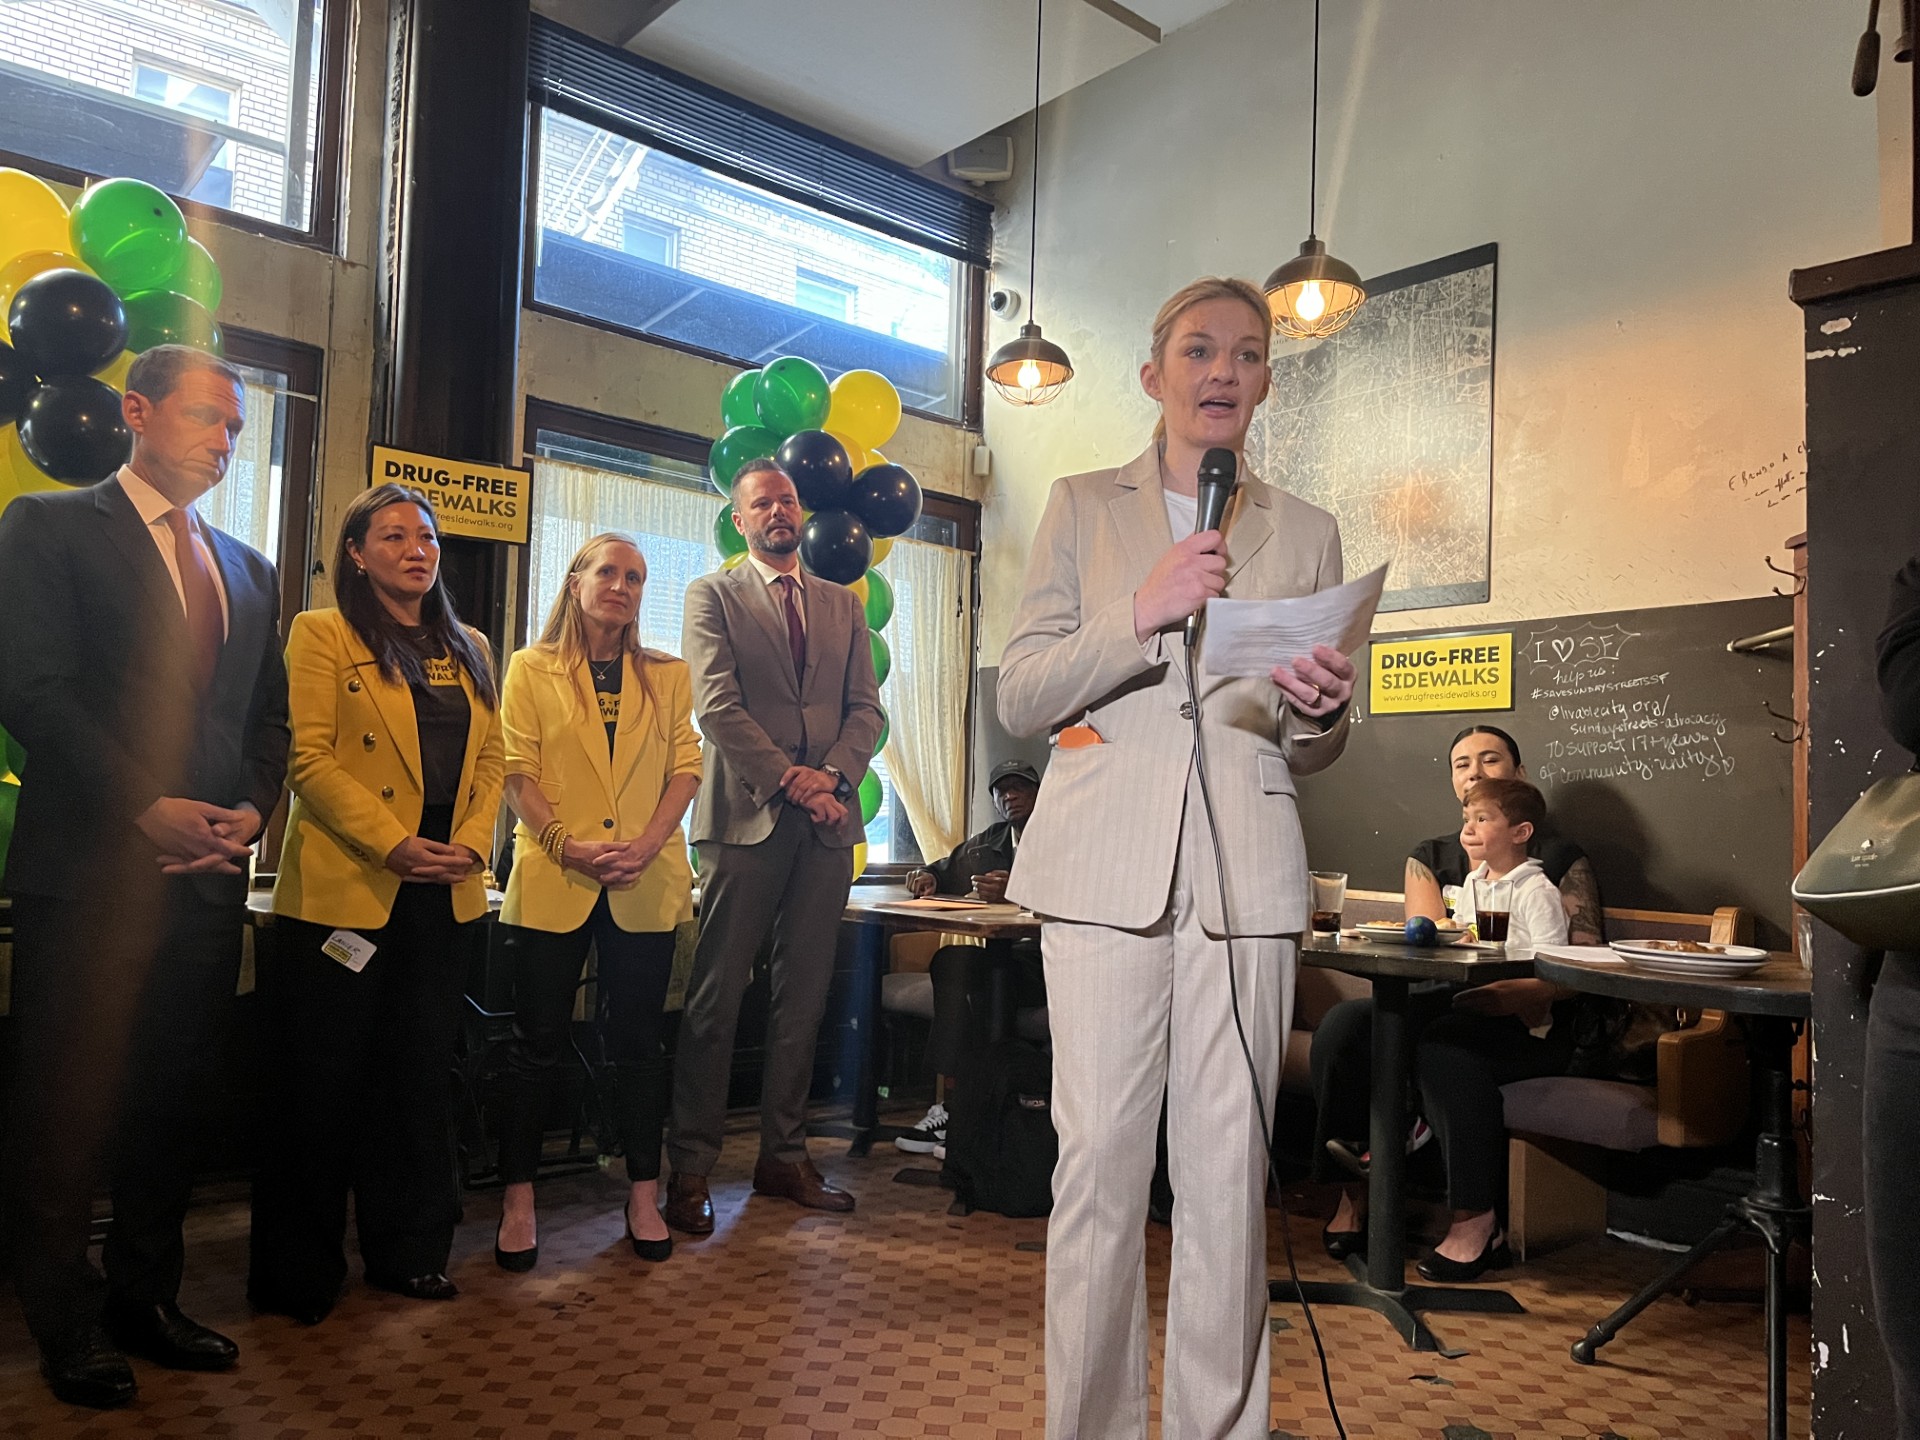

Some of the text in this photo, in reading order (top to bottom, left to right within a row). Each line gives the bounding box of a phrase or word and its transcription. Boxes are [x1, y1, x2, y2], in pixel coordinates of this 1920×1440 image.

[385, 460, 518, 497] DRUG-FREE
[434, 512, 513, 531] reesidewalks.org
[1381, 646, 1500, 669] DRUG-FREE
[1533, 633, 1614, 663] I SF
[1381, 667, 1500, 690] SIDEWALKS
[1530, 671, 1670, 699] #SAVESUNDAYSTREETSSF
[1553, 669, 1585, 687] help
[1383, 689, 1497, 702] www.drugfreesidewalks.org
[1566, 737, 1626, 757] SUPPORT
[1539, 761, 1557, 788] of
